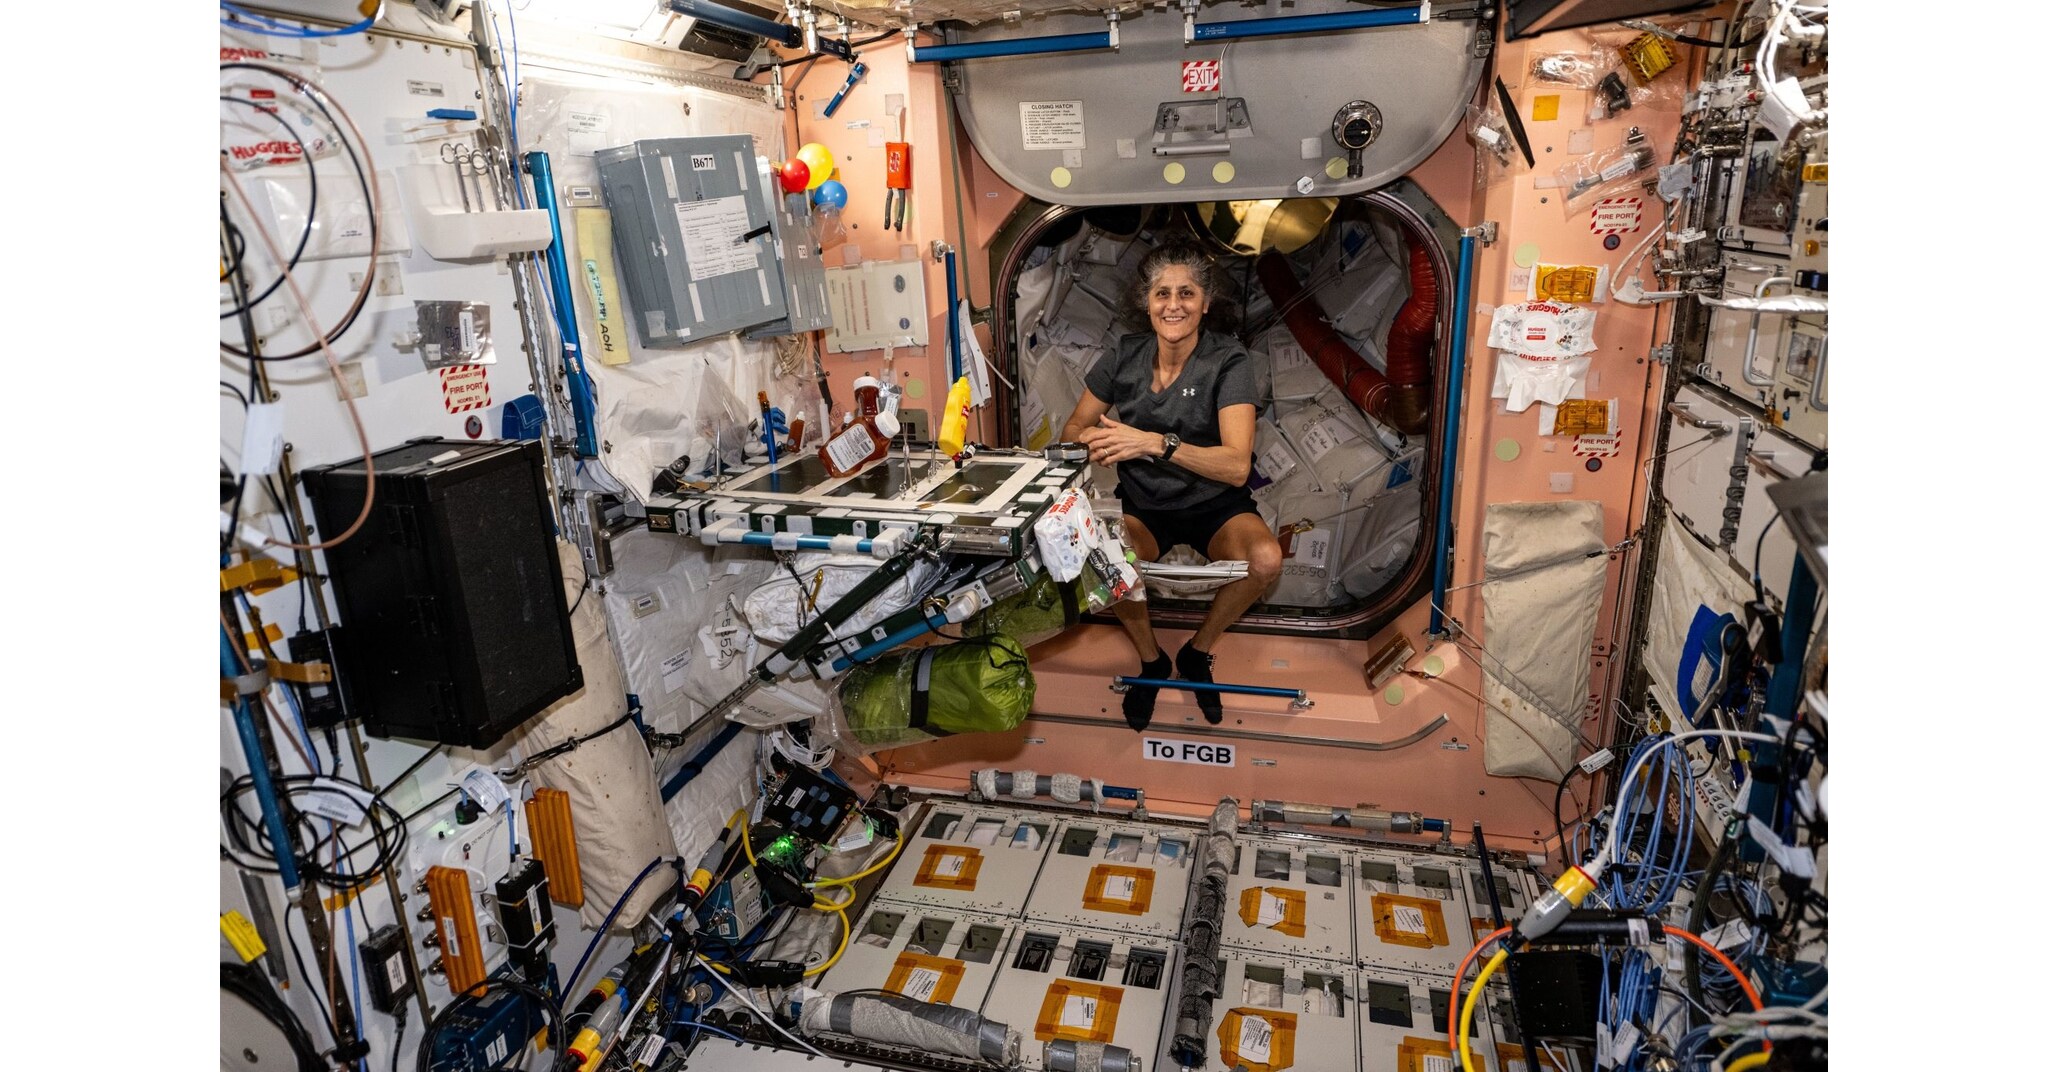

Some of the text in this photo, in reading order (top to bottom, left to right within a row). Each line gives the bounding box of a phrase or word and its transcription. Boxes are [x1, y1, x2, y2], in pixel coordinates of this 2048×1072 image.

[1188, 69, 1213, 85] EXIT
[230, 141, 302, 159] HUGGIES
[692, 157, 713, 168] B677
[1526, 303, 1560, 316] HUGGIES
[446, 373, 472, 381] EMERGENCY
[450, 382, 483, 394] FIRE PORT
[1147, 740, 1231, 764] To FGB
